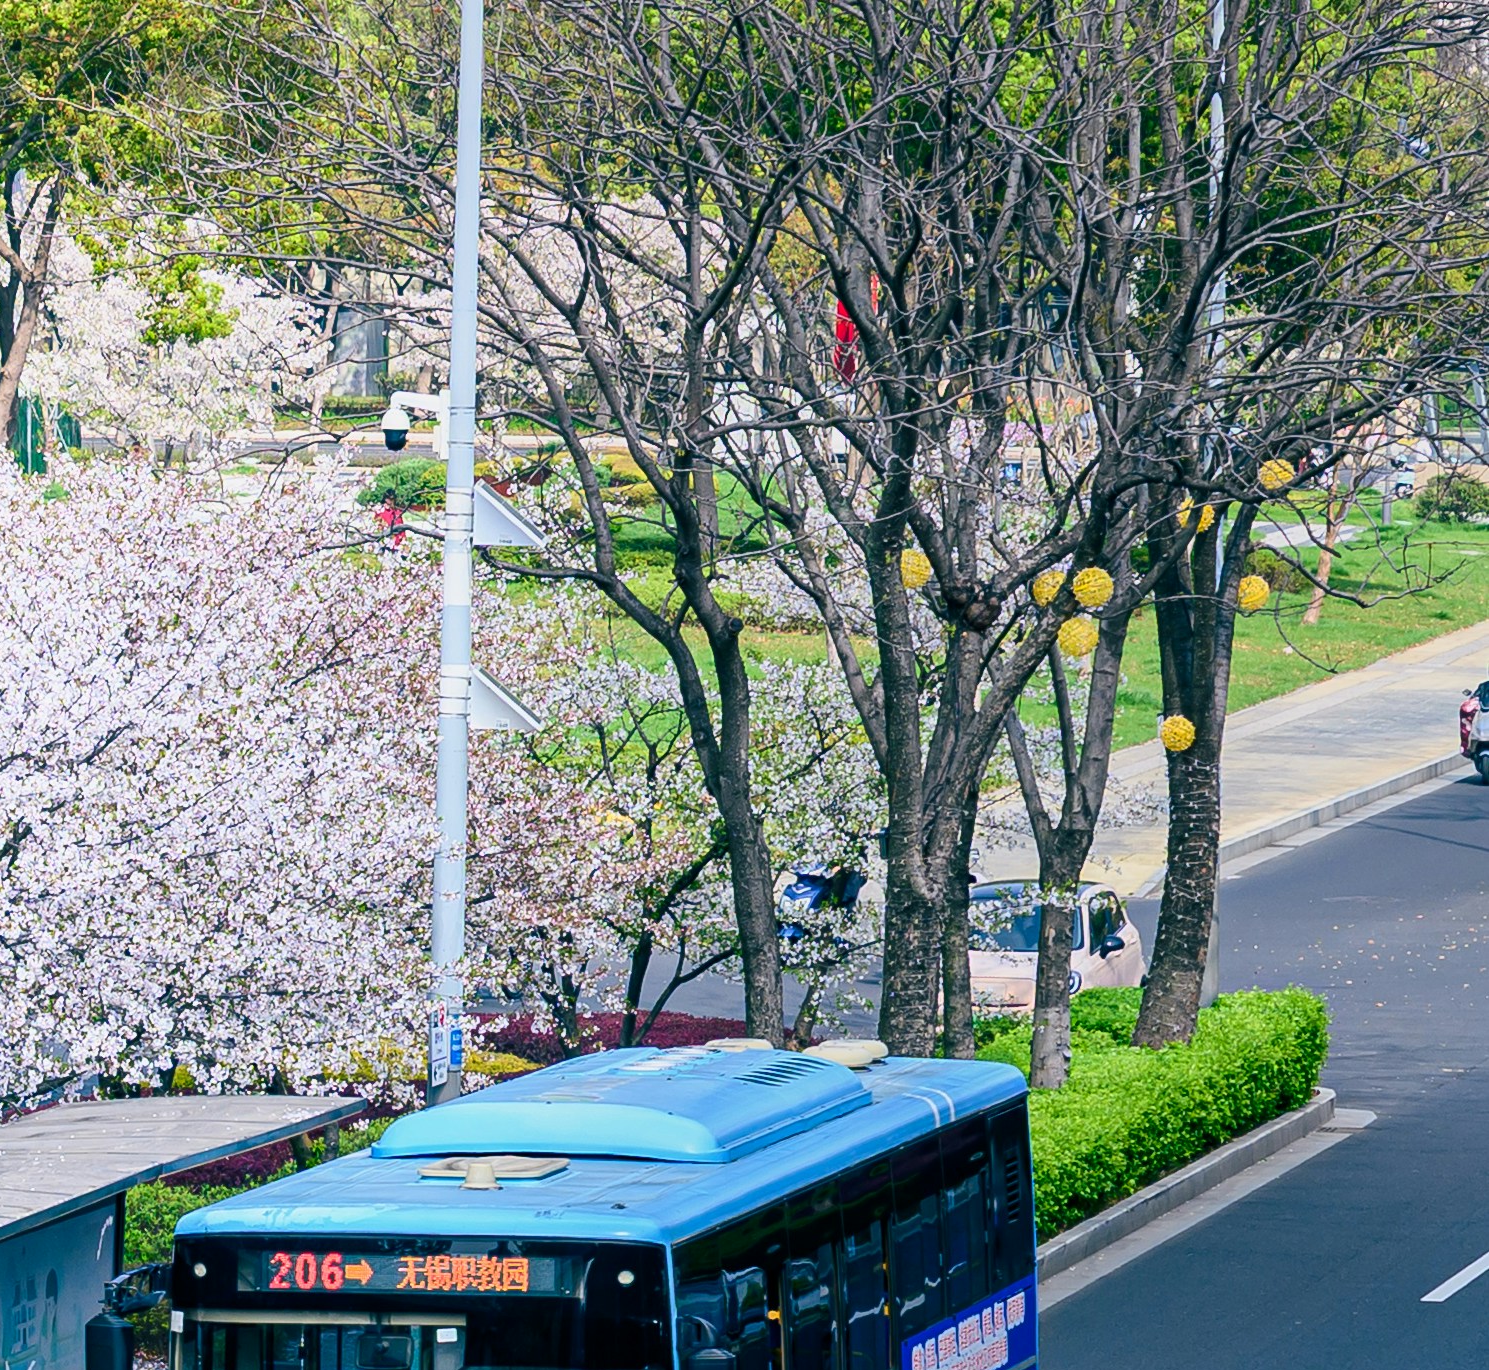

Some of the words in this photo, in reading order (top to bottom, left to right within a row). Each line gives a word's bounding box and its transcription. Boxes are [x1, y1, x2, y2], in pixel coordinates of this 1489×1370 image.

[268, 1253, 344, 1290] 206
[396, 1256, 529, 1292] 无锡职教园
